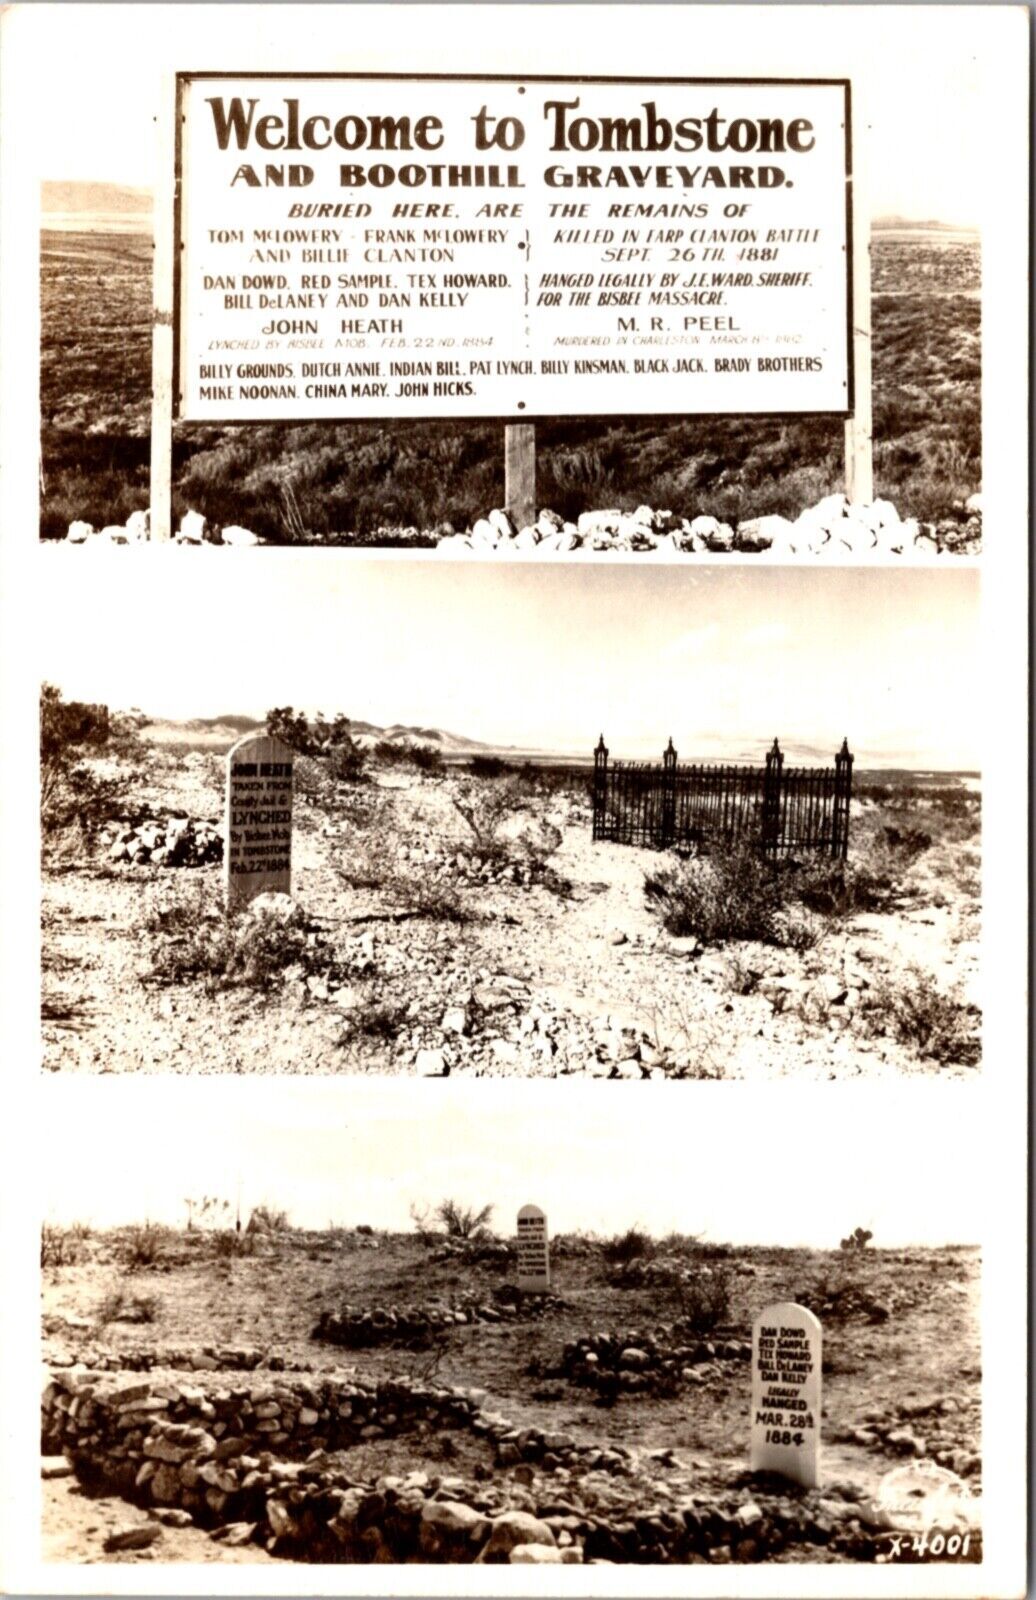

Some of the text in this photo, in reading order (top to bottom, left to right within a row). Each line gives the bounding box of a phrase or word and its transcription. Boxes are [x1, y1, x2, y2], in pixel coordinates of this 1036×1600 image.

[204, 97, 816, 153] Welcome to Tombstone
[231, 164, 793, 188] AND BOOTHILL GRAVEYARD.
[288, 204, 372, 218] BURIED
[476, 204, 523, 217] ARE
[549, 204, 590, 217] THE
[608, 204, 708, 217] REMAINS
[723, 204, 752, 217] OF
[208, 230, 243, 243] TOM
[365, 230, 416, 243] FRANK
[554, 229, 614, 243] KILLED
[622, 230, 640, 243] IN
[690, 229, 758, 243] CLANTON
[766, 229, 820, 242] BATTLE
[249, 249, 454, 263] AND BILLIE CLANTON
[667, 248, 695, 261] 26
[738, 248, 779, 261] 1881
[204, 274, 512, 290] DAN DOWD. RED SAMPLE. TEX HOWARD.
[539, 273, 594, 288] HANGED
[598, 273, 655, 287] LEGALLY
[660, 273, 680, 287] BY
[224, 293, 468, 309] BILL DeLANEY AND DAN KELLY
[536, 291, 727, 306] FOR THE BISBEE MASSACRE.
[262, 319, 403, 334] JOHN HEATH
[617, 317, 740, 331] M. R. PEEL
[208, 339, 260, 350] LYNCHED
[265, 340, 281, 350] BY
[413, 337, 434, 348] 22
[553, 336, 611, 346] MURDERED
[200, 364, 232, 379] BILLY
[301, 363, 341, 377] DUTCH
[390, 362, 432, 376] INDIAN
[470, 361, 492, 375] PAT
[497, 360, 537, 375] LYNCH.
[541, 360, 569, 374] BILLY
[574, 360, 629, 374] KINSMAN.
[634, 359, 669, 373] BLACK
[672, 359, 708, 373] JACK.
[715, 358, 751, 372] BRADY
[757, 357, 822, 372] BROTHERS
[200, 381, 477, 400] MIKE NOONAN. CHINA MARY. JOHN HICKS.
[232, 782, 263, 791] TAKEN
[232, 811, 291, 825] LYNCHED
[761, 1326, 806, 1338] DAN DOWD
[759, 1338, 809, 1350] RED SAMPLE
[760, 1349, 812, 1361] TEX HOWARD
[758, 1360, 774, 1370] BILL
[762, 1371, 807, 1384] DAN KELLY
[762, 1397, 807, 1411] HANGED
[756, 1411, 788, 1427] MAR.
[766, 1430, 804, 1446] 1884
